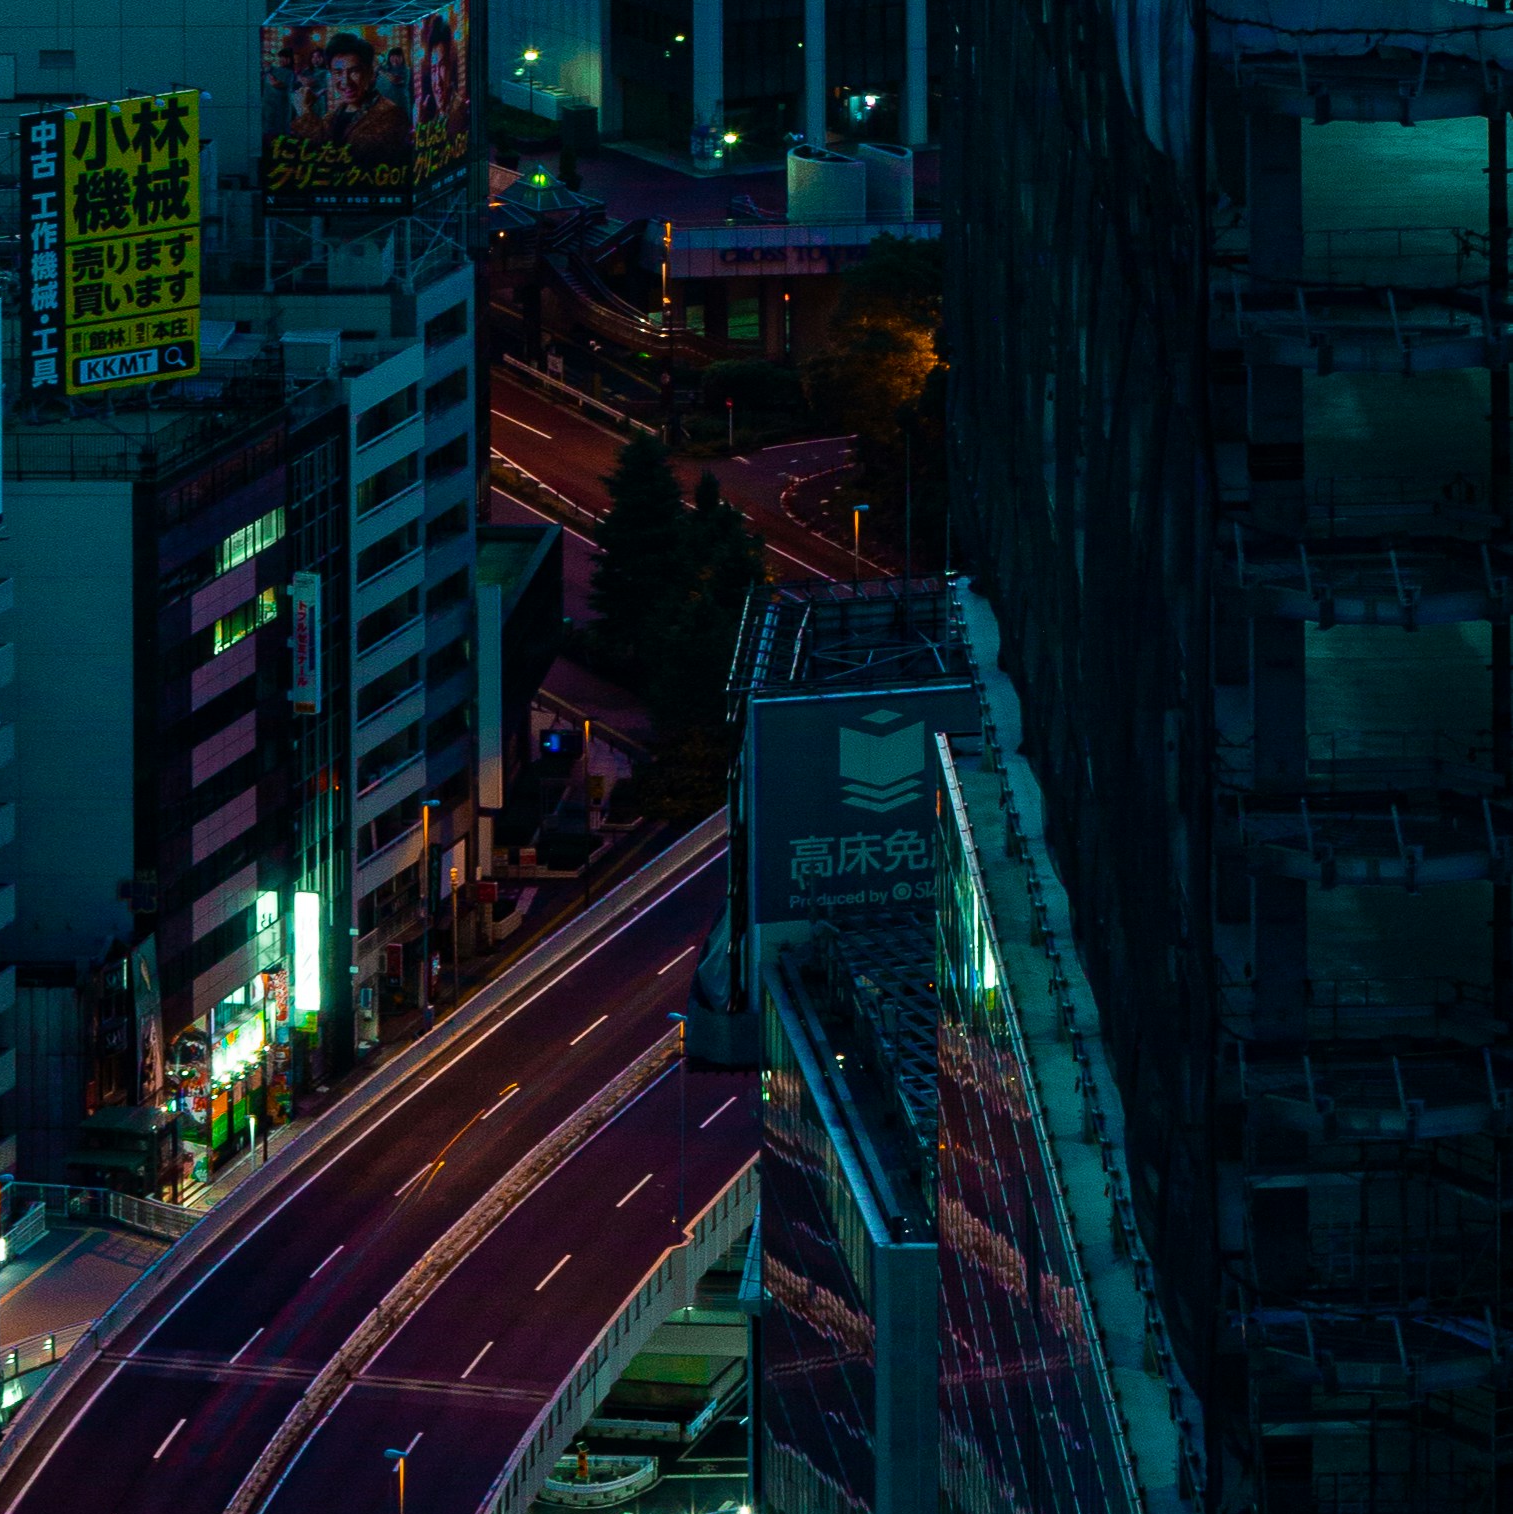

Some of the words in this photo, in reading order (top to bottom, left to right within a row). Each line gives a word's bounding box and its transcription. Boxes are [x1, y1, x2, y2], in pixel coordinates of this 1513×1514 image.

[30, 120, 58, 181] 中古
[72, 97, 190, 170] 小林
[271, 134, 354, 164] にしたん
[72, 158, 190, 235] 機械
[72, 233, 194, 282] 売ります
[30, 191, 59, 388] 工作機械・工具
[72, 269, 194, 320] 買います
[87, 353, 154, 381] KKMT
[789, 828, 936, 890] 高床免
[869, 889, 889, 905] by
